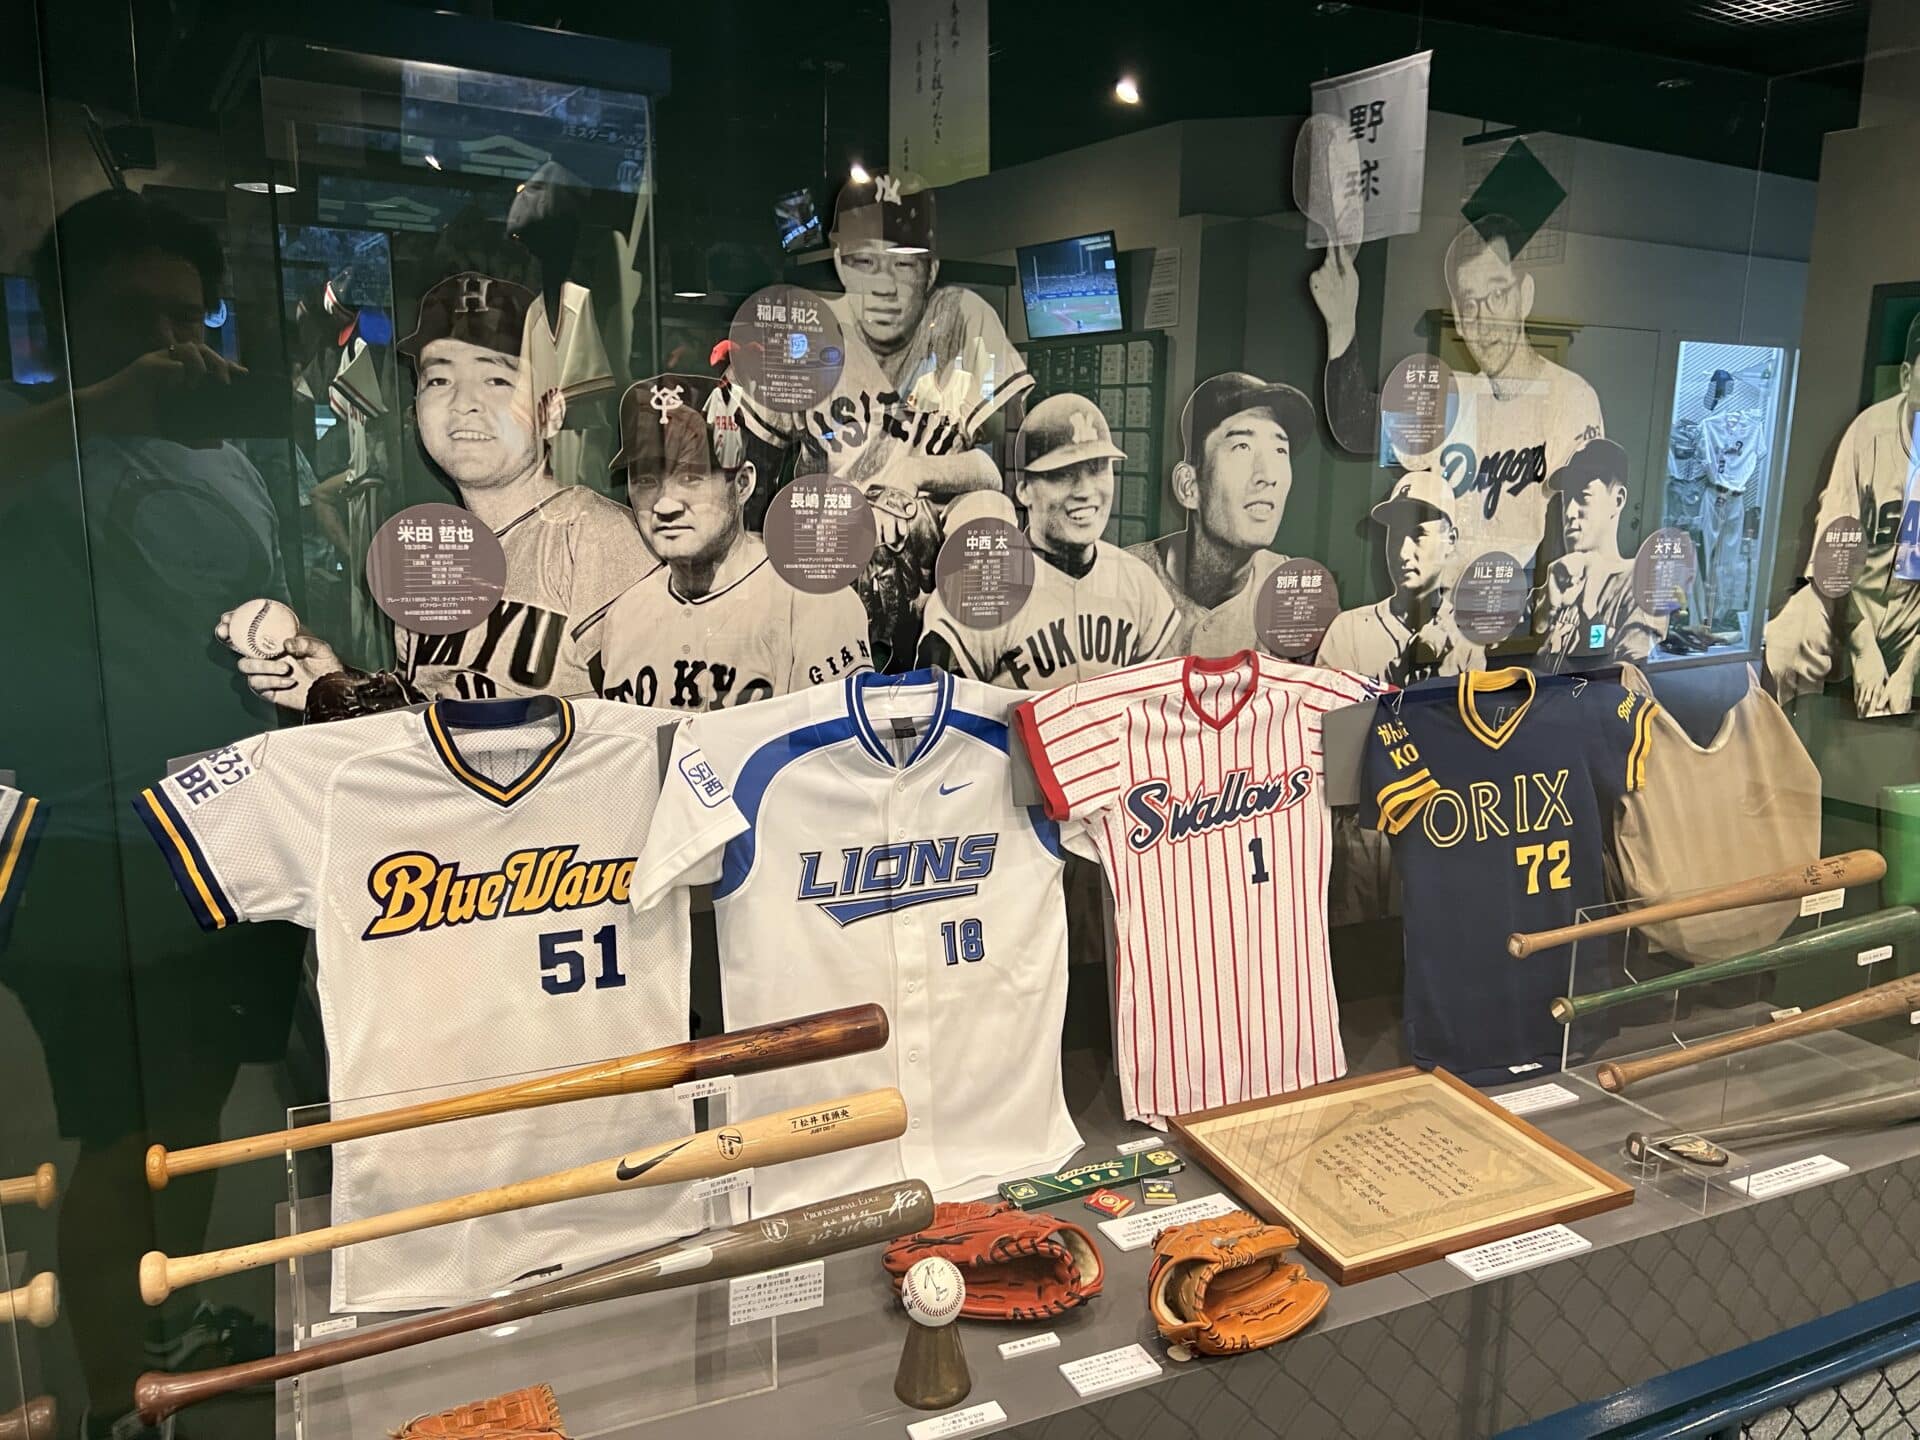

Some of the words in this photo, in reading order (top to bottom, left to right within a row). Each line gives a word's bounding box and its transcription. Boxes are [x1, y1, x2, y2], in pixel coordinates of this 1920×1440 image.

[455, 278, 493, 313] H
[757, 304, 786, 322] 稲尾
[791, 306, 820, 325] 和久
[1405, 370, 1426, 383] 杉下
[790, 493, 819, 508] 長嶋
[823, 493, 852, 509] 茂雄
[397, 525, 433, 543] 米田
[438, 525, 474, 543] 哲也
[966, 535, 992, 550] 中西
[995, 535, 1008, 549] 太
[1654, 542, 1672, 554] 大下
[1276, 575, 1299, 588] 別所
[1473, 566, 1493, 579] 川上
[1495, 566, 1514, 578] 哲治
[1389, 743, 1419, 770] KO
[175, 764, 219, 806] BE
[1124, 766, 1313, 855] Swallows
[1422, 769, 1576, 847] ORIX
[797, 833, 999, 901] LIONS
[1248, 837, 1270, 885] 1
[1515, 839, 1573, 896] 72
[940, 918, 985, 966] 18
[537, 924, 627, 996] 51
[791, 1120, 797, 1129] 7
[800, 1115, 819, 1128] 松井
